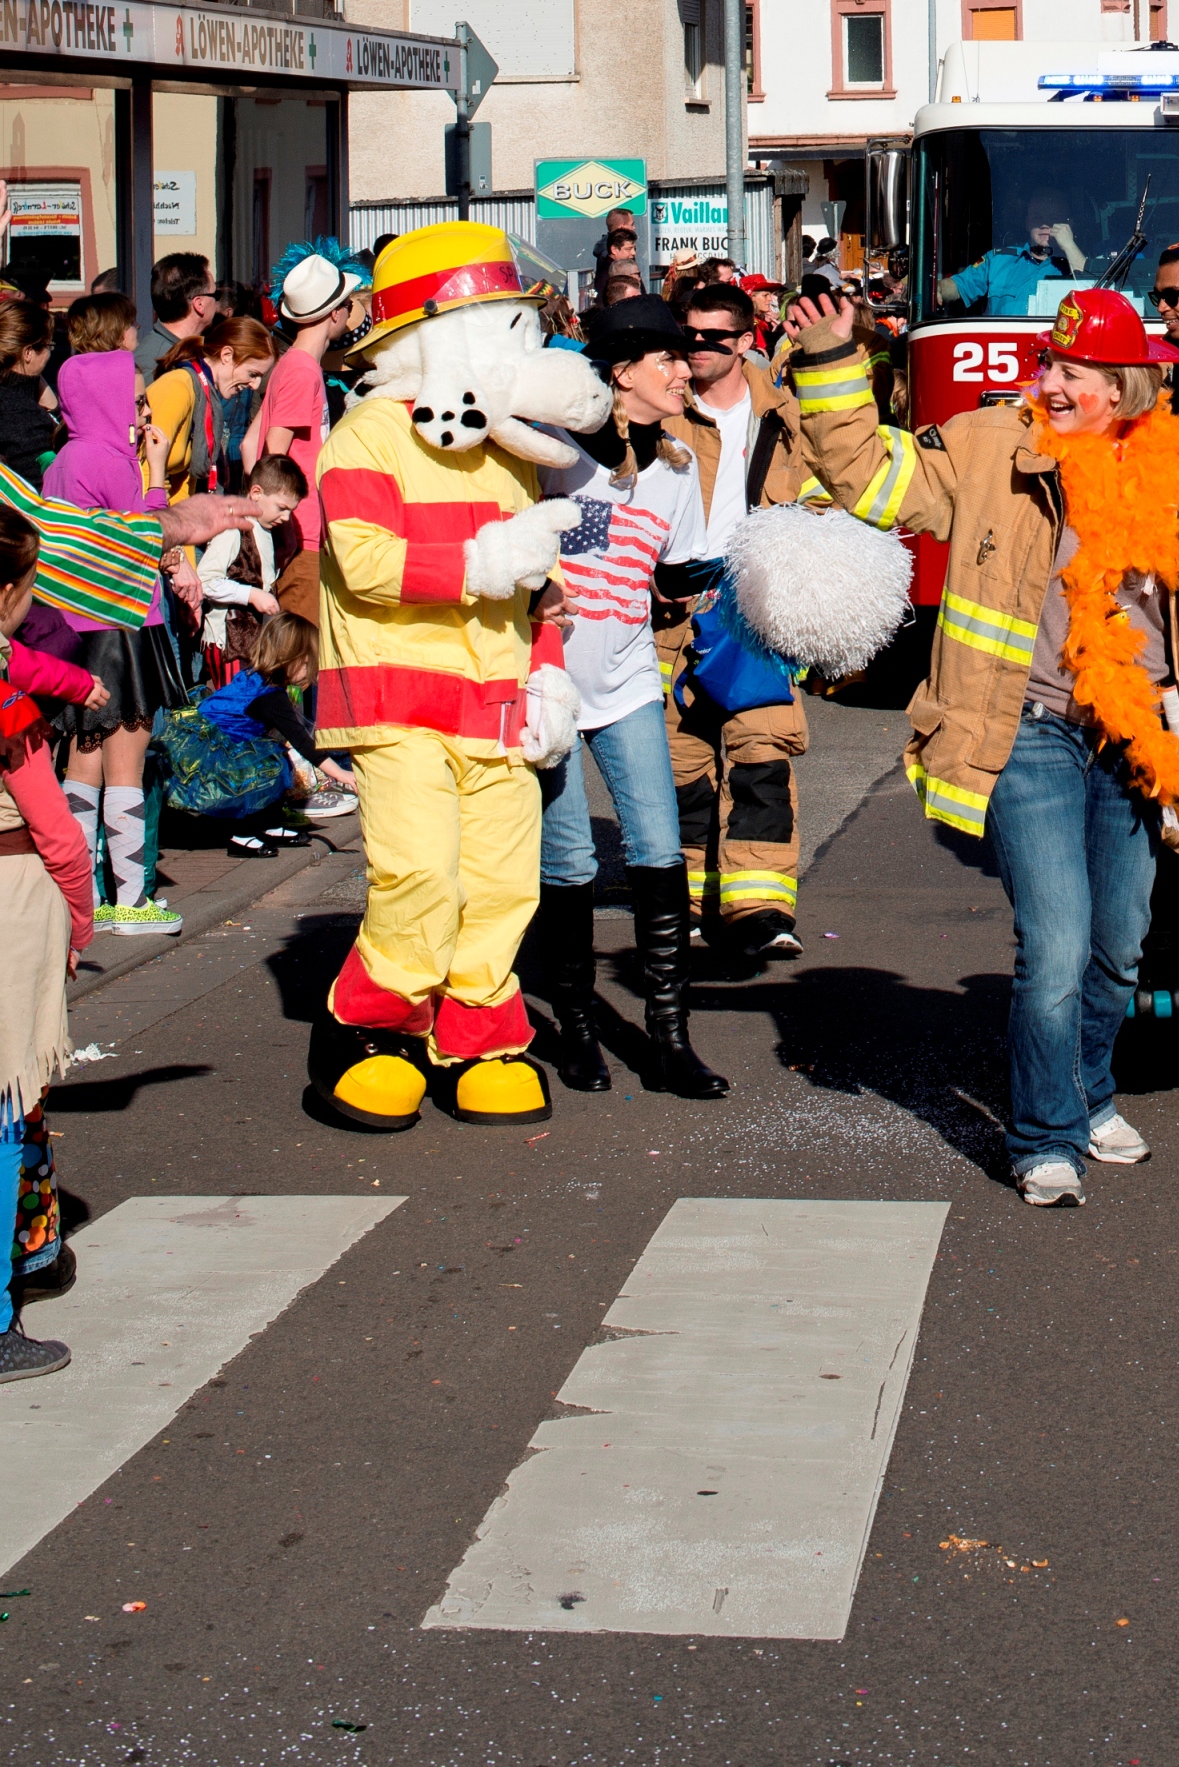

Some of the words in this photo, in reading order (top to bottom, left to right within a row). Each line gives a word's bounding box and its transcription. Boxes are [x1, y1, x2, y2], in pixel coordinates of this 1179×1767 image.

[190, 14, 305, 70] LÖWEN-APOTHEKE
[357, 37, 441, 83] LÖWEN-APOTHEKE
[553, 181, 633, 201] BUCK
[655, 236, 698, 251] FRANK
[703, 236, 729, 251] BUC
[953, 342, 1019, 382] 25
